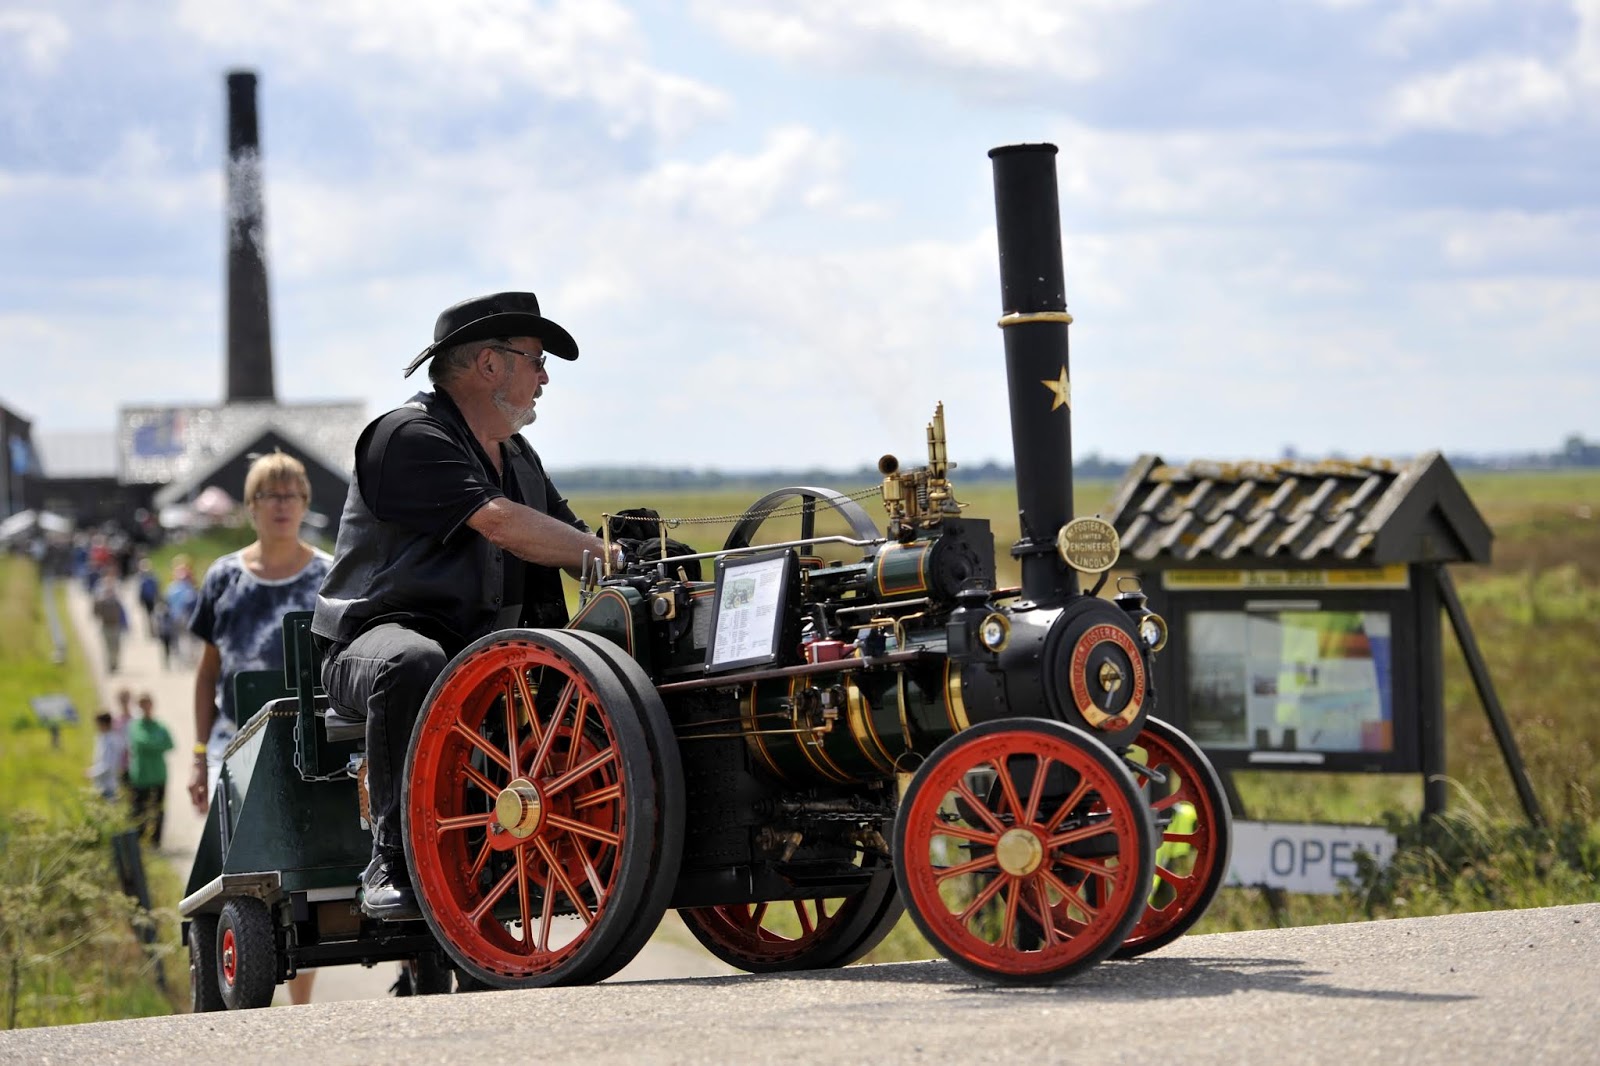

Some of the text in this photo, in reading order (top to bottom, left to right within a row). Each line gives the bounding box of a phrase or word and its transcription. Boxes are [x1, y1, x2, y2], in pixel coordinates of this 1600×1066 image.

[1074, 521, 1100, 533] FOSTER
[1070, 542, 1111, 552] ENGINEERS
[1074, 555, 1110, 568] LINCOLN
[1083, 627, 1110, 649] FOSTER
